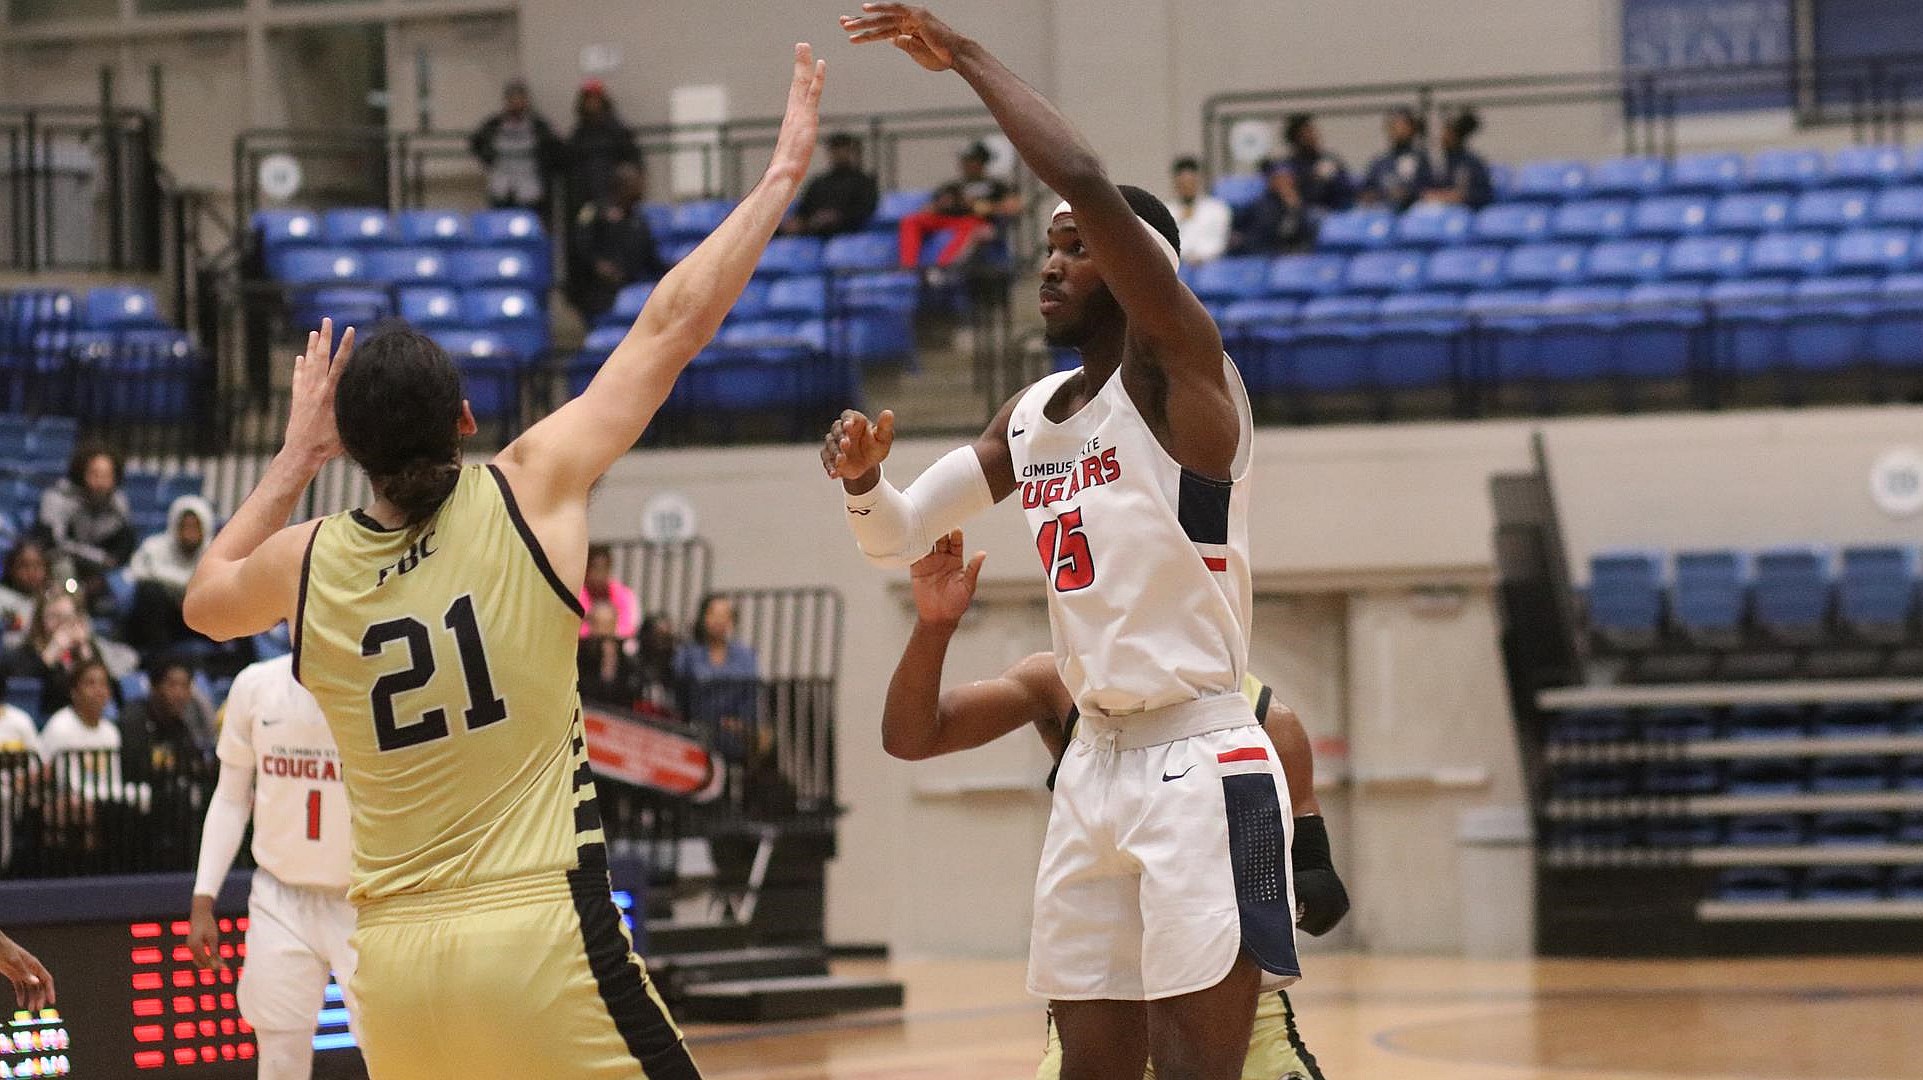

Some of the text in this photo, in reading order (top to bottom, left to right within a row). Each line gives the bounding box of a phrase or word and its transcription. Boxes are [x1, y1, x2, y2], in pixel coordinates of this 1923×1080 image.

[1015, 446, 1121, 510] UGARS
[1023, 461, 1072, 477] UMBUS
[1036, 506, 1095, 592] 15
[361, 594, 508, 752] 21
[262, 755, 343, 782] COUGA
[306, 789, 321, 841] 1
